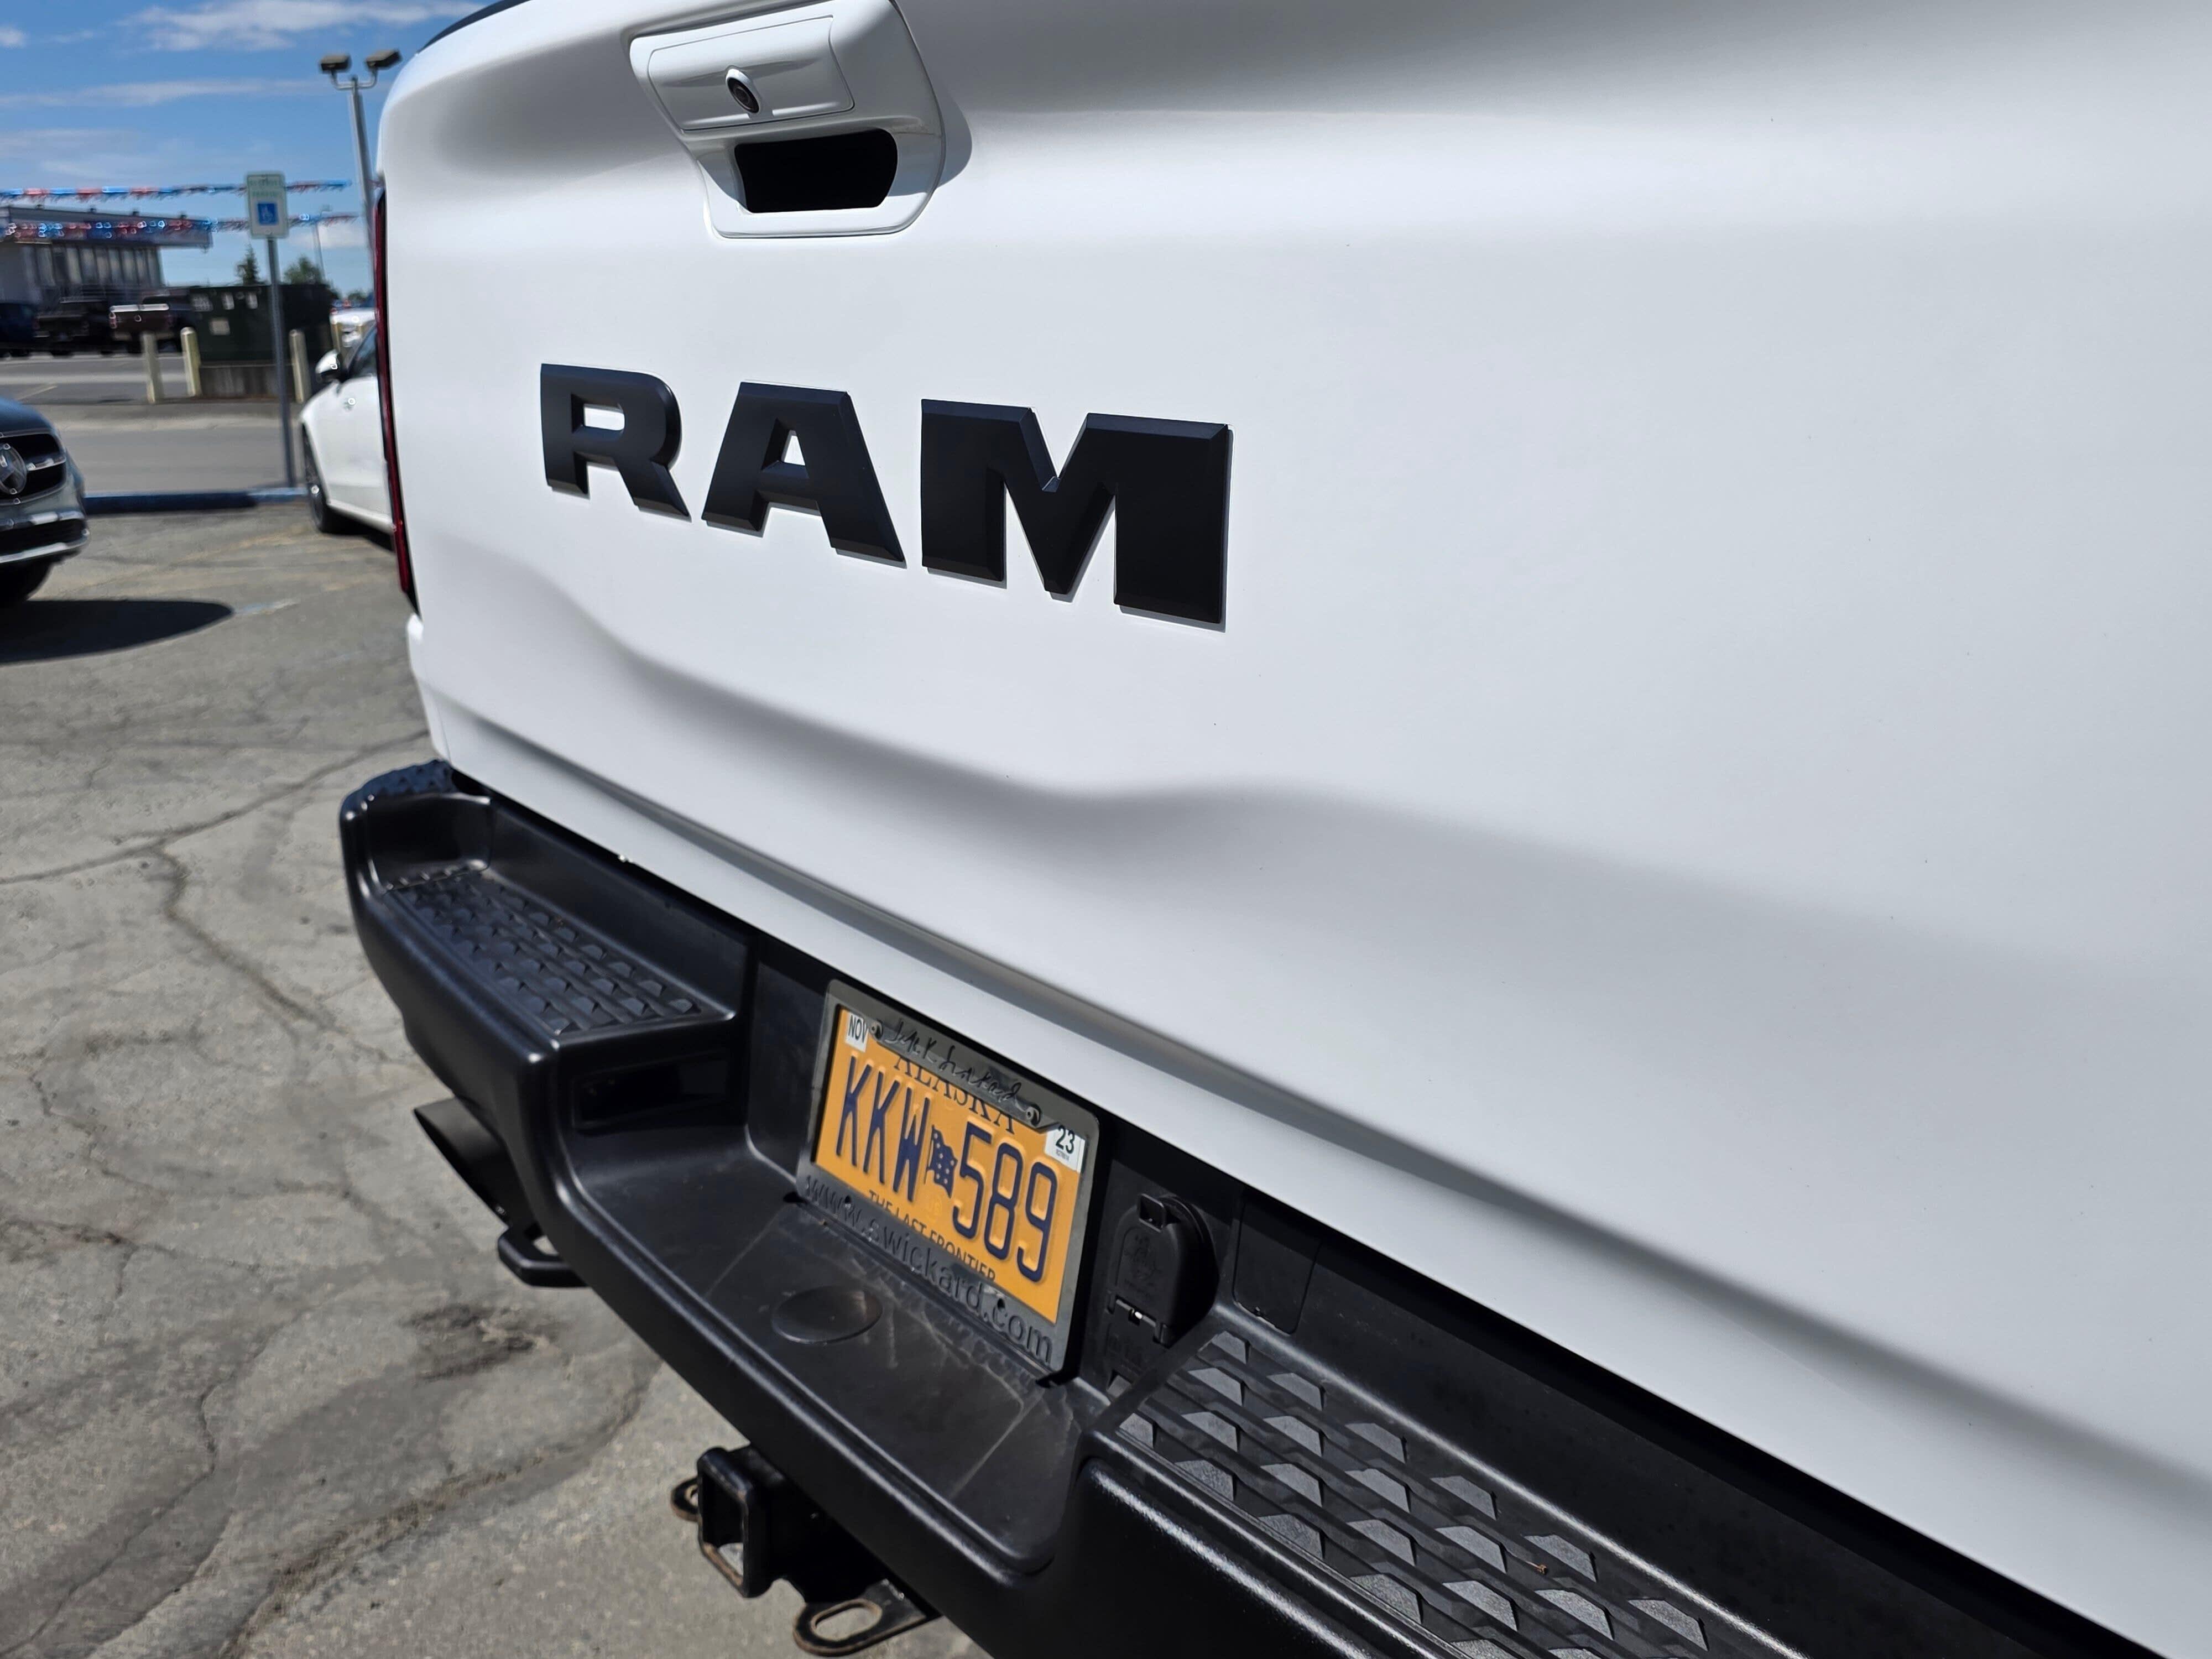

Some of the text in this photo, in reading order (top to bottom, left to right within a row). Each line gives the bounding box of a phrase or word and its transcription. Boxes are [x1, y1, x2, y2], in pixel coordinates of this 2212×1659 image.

[540, 363, 1230, 625] RAM
[848, 1014, 868, 1044] NOV
[836, 1055, 931, 1202] KKW
[953, 1121, 1058, 1282] 589
[1056, 1125, 1075, 1154] 23
